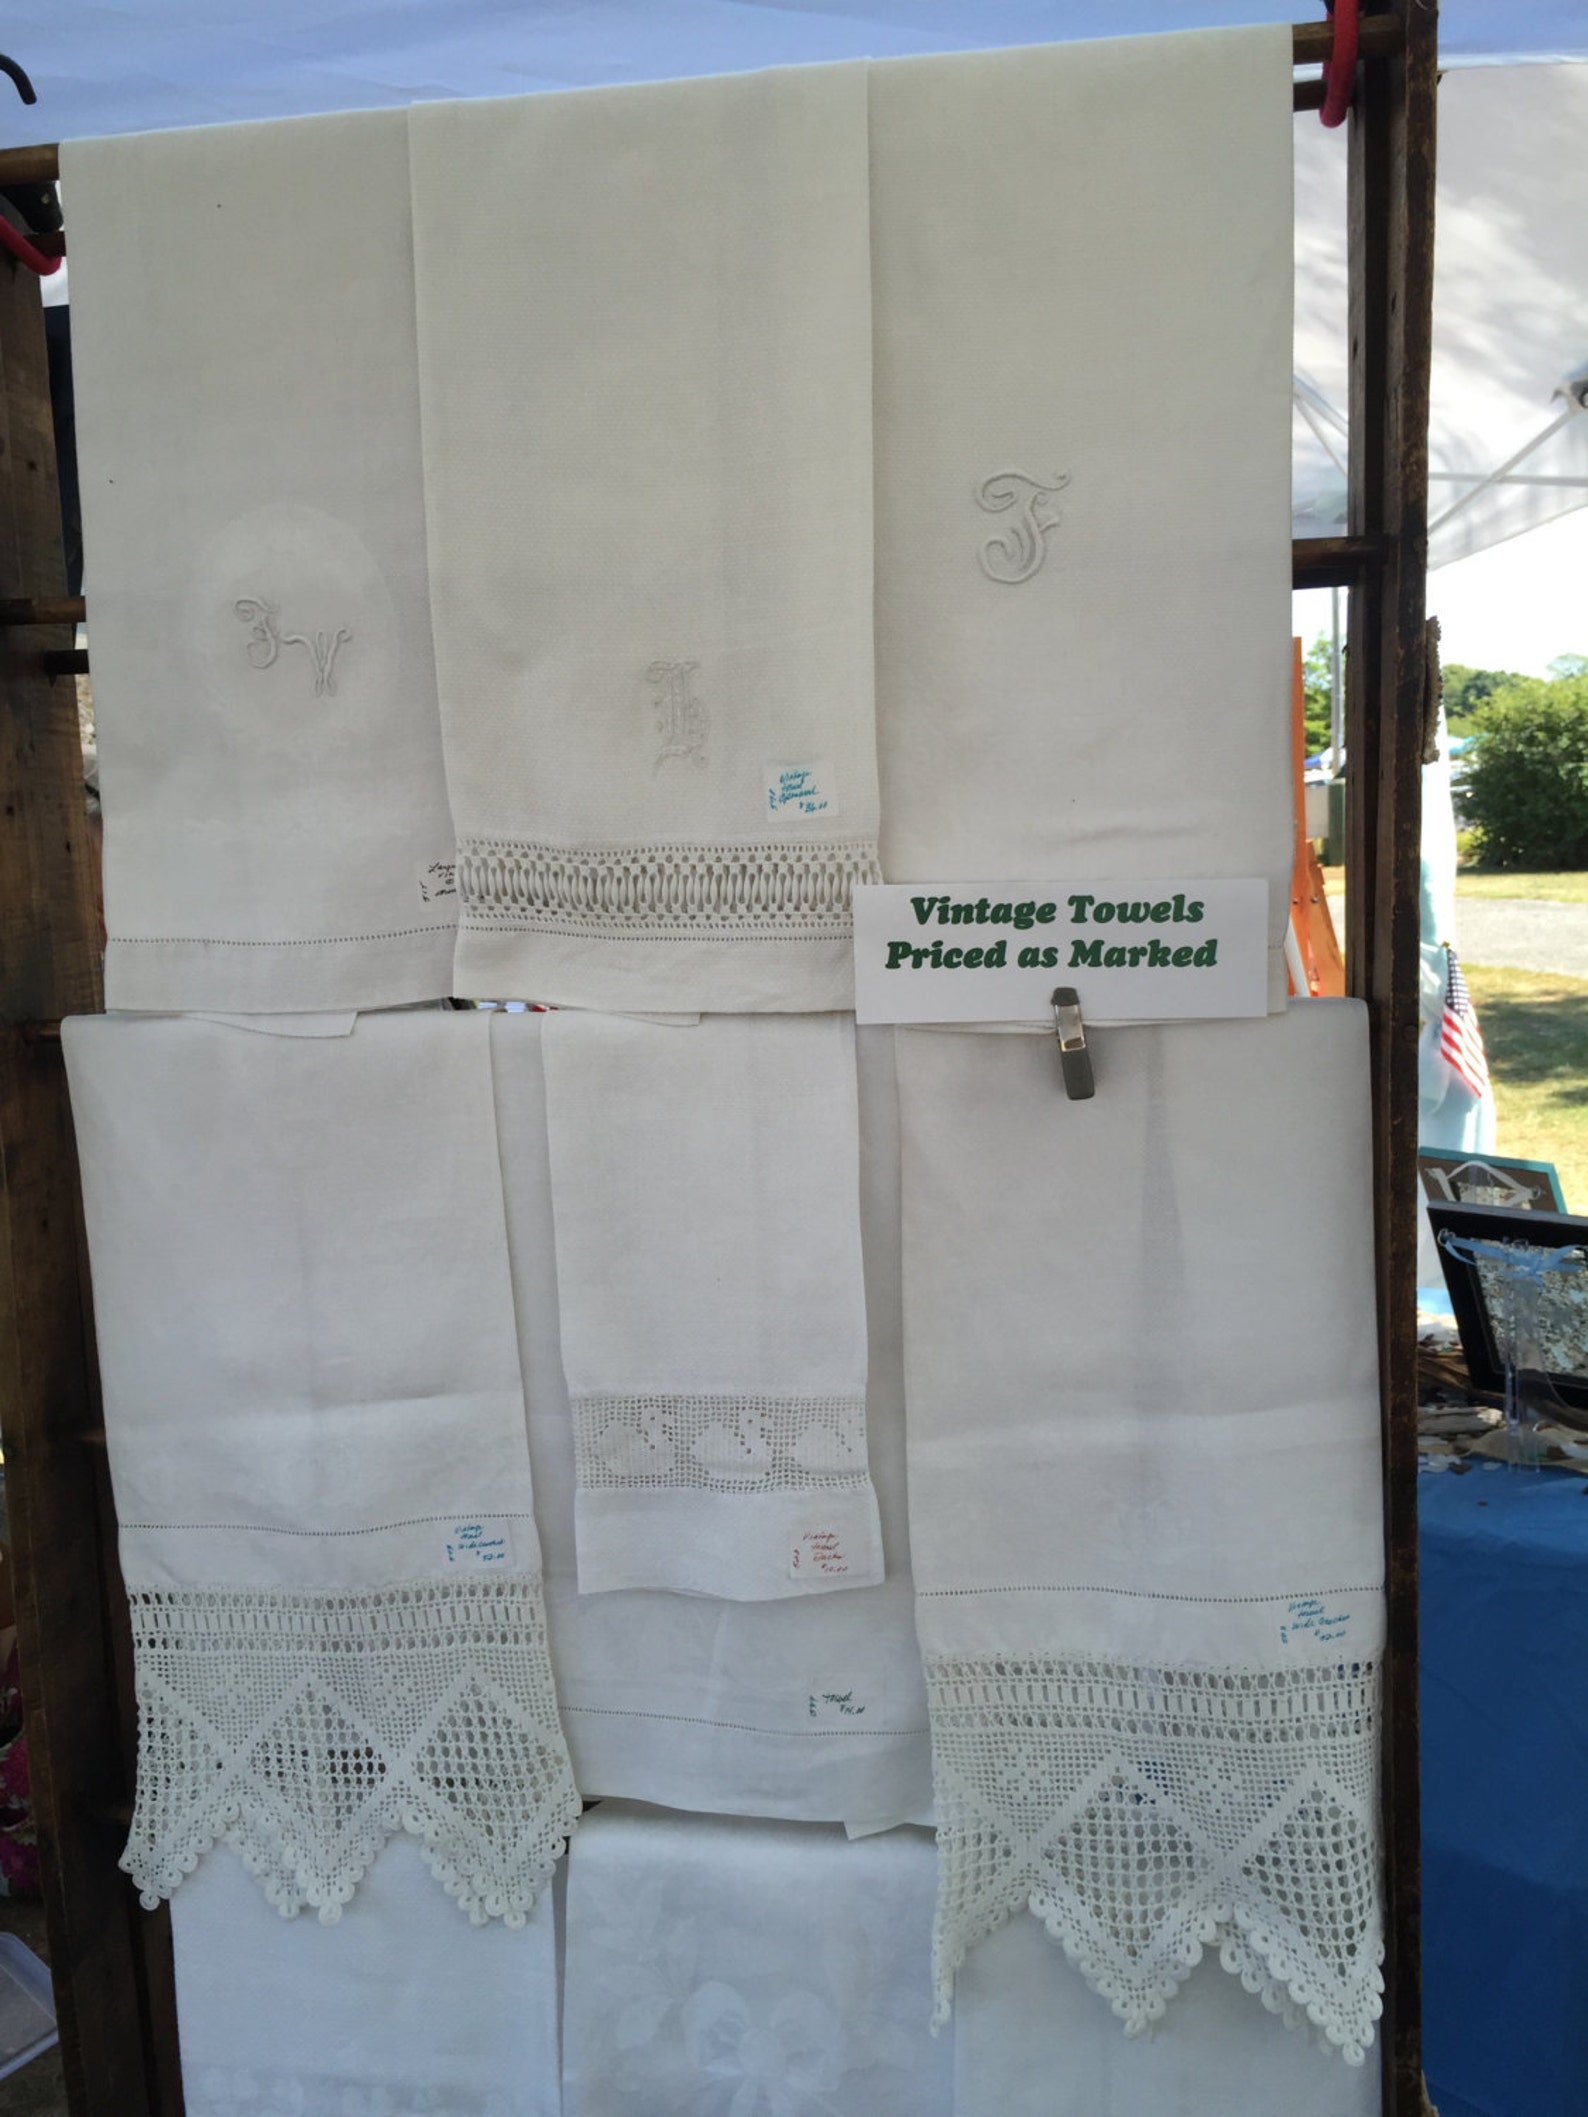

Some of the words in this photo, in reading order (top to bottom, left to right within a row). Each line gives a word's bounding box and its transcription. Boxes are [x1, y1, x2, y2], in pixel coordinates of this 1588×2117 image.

[910, 895, 1057, 930] Vintage
[1067, 894, 1205, 924] Towels
[885, 940, 1008, 970] Priced
[1017, 945, 1059, 969] as
[1067, 938, 1219, 969] Marked
